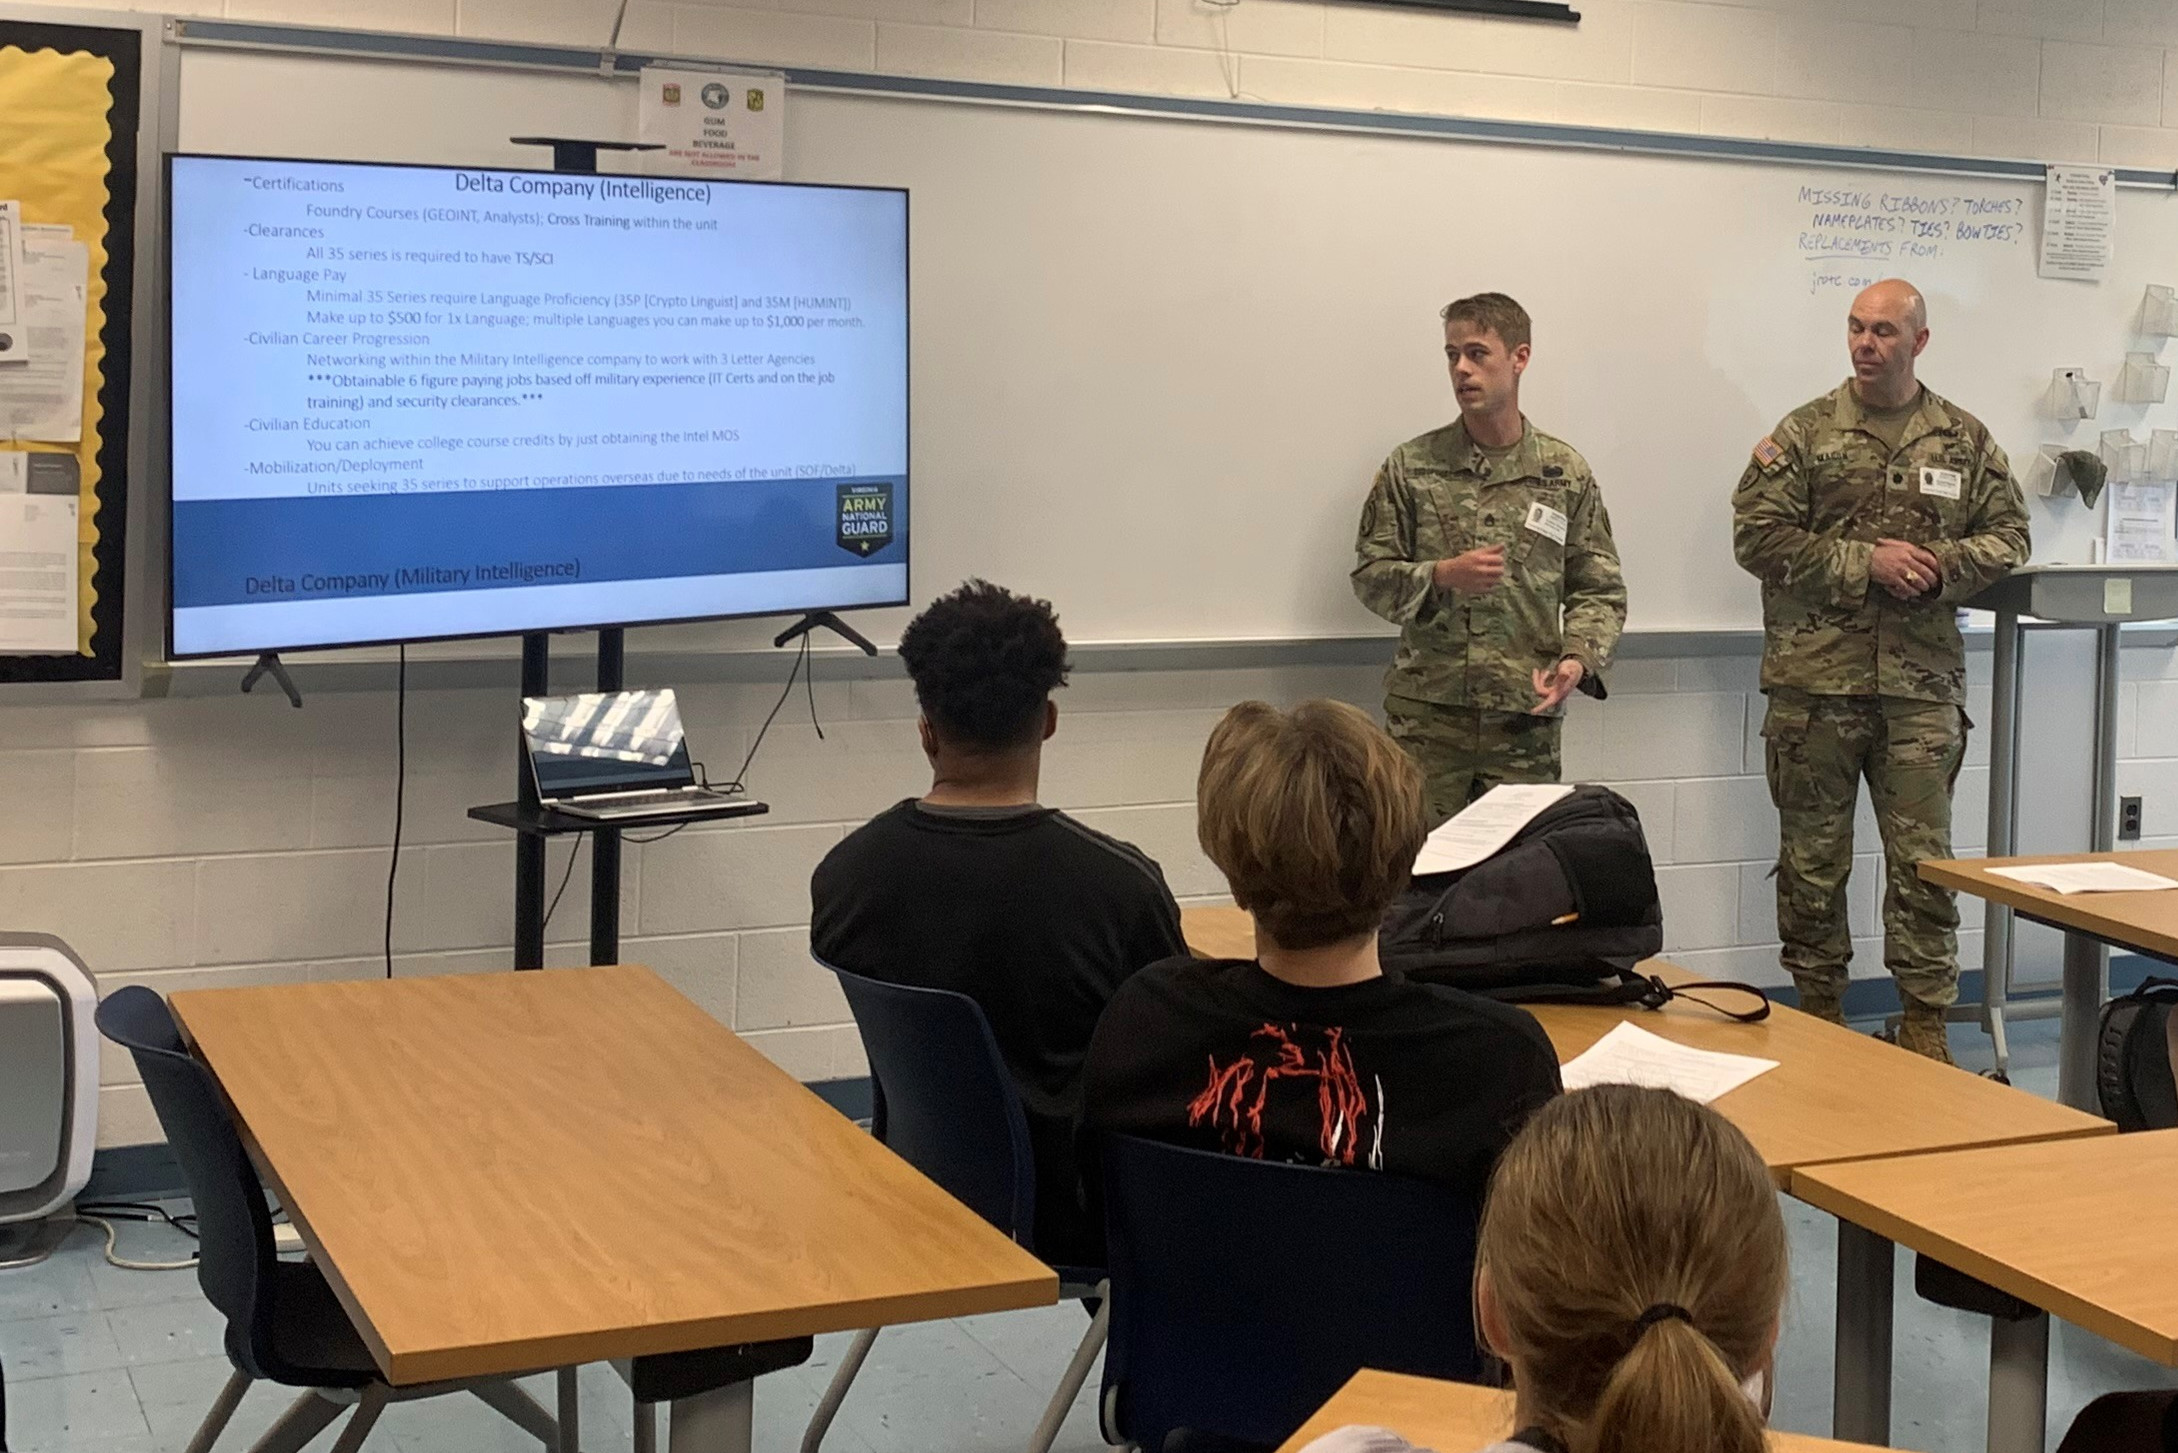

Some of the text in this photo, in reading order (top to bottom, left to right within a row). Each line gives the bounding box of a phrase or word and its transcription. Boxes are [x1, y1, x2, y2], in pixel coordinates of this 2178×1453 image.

[704, 117, 725, 126] GUM
[704, 129, 728, 138] FOOD
[693, 141, 735, 150] BEVERAGE
[455, 173, 711, 204] Delta Company (Intelligence)
[1799, 186, 2023, 215] MISSING RIBBONS? TORCHES?
[306, 204, 362, 221] Foundry
[367, 206, 418, 220] Courses
[423, 207, 480, 224] (GEOINT,
[547, 213, 580, 226] Cross
[584, 214, 630, 230] Training
[633, 217, 669, 229] within
[673, 218, 692, 230] the
[695, 219, 717, 231] unit
[1813, 213, 1905, 232] NAMEPLATES?
[1911, 221, 1950, 238] TIES?
[244, 223, 324, 239] -Clearances
[1799, 232, 1892, 255] REPLACEMENTS
[306, 247, 553, 265] All 35 series is required to have TS/SCI
[253, 267, 319, 283] Language
[324, 268, 347, 283] Pay
[307, 289, 362, 303] Minimal
[367, 290, 383, 303] 35
[387, 291, 426, 303] Series
[430, 292, 477, 306] require
[481, 292, 540, 307] Language
[544, 293, 611, 308] Proficiency
[741, 296, 763, 308] and
[765, 296, 790, 308] 35M
[307, 311, 865, 329] Make up to $500 for 1x Language; multiple Languages you can make up to $1,000 per month.
[244, 332, 430, 347] -Civilian Career Progression
[307, 353, 816, 369] Networking within the Military Intelligence company to work with 3 Letter Agencies
[409, 374, 417, 387] 6
[421, 374, 458, 389] figure
[462, 374, 503, 389] paying
[506, 373, 532, 389] jobs
[536, 373, 572, 386] based
[575, 373, 592, 385] off
[595, 373, 639, 387] military
[643, 373, 705, 385] experience
[708, 372, 722, 386] (IT
[726, 372, 755, 384] Certs
[757, 373, 778, 384] and
[781, 374, 795, 383] on
[798, 372, 816, 383] the
[818, 372, 835, 386] job
[307, 395, 364, 411] training)
[368, 395, 392, 408] and
[396, 394, 447, 409] security
[244, 417, 370, 431] -Civilian Education
[307, 429, 740, 451] You can achieve college course credits by just obtaining the Intel MOS
[244, 458, 424, 475] -Mobilization/Deployment
[307, 481, 343, 494] Units
[347, 479, 397, 495] seeking
[402, 478, 418, 490] 35
[422, 477, 460, 489] series
[463, 477, 477, 489] to
[480, 475, 529, 491] support
[533, 473, 599, 488] operations
[602, 471, 653, 484] overseas
[657, 469, 679, 482] due
[683, 469, 695, 481] to
[697, 468, 732, 480] needs
[735, 467, 747, 479] of
[749, 466, 768, 479] the
[771, 466, 792, 478] unit
[843, 498, 886, 512] ARMY
[842, 512, 887, 521] NATIONAL
[842, 521, 888, 535] GUARD
[245, 558, 581, 595] Delta Company (Military Intelligence)
